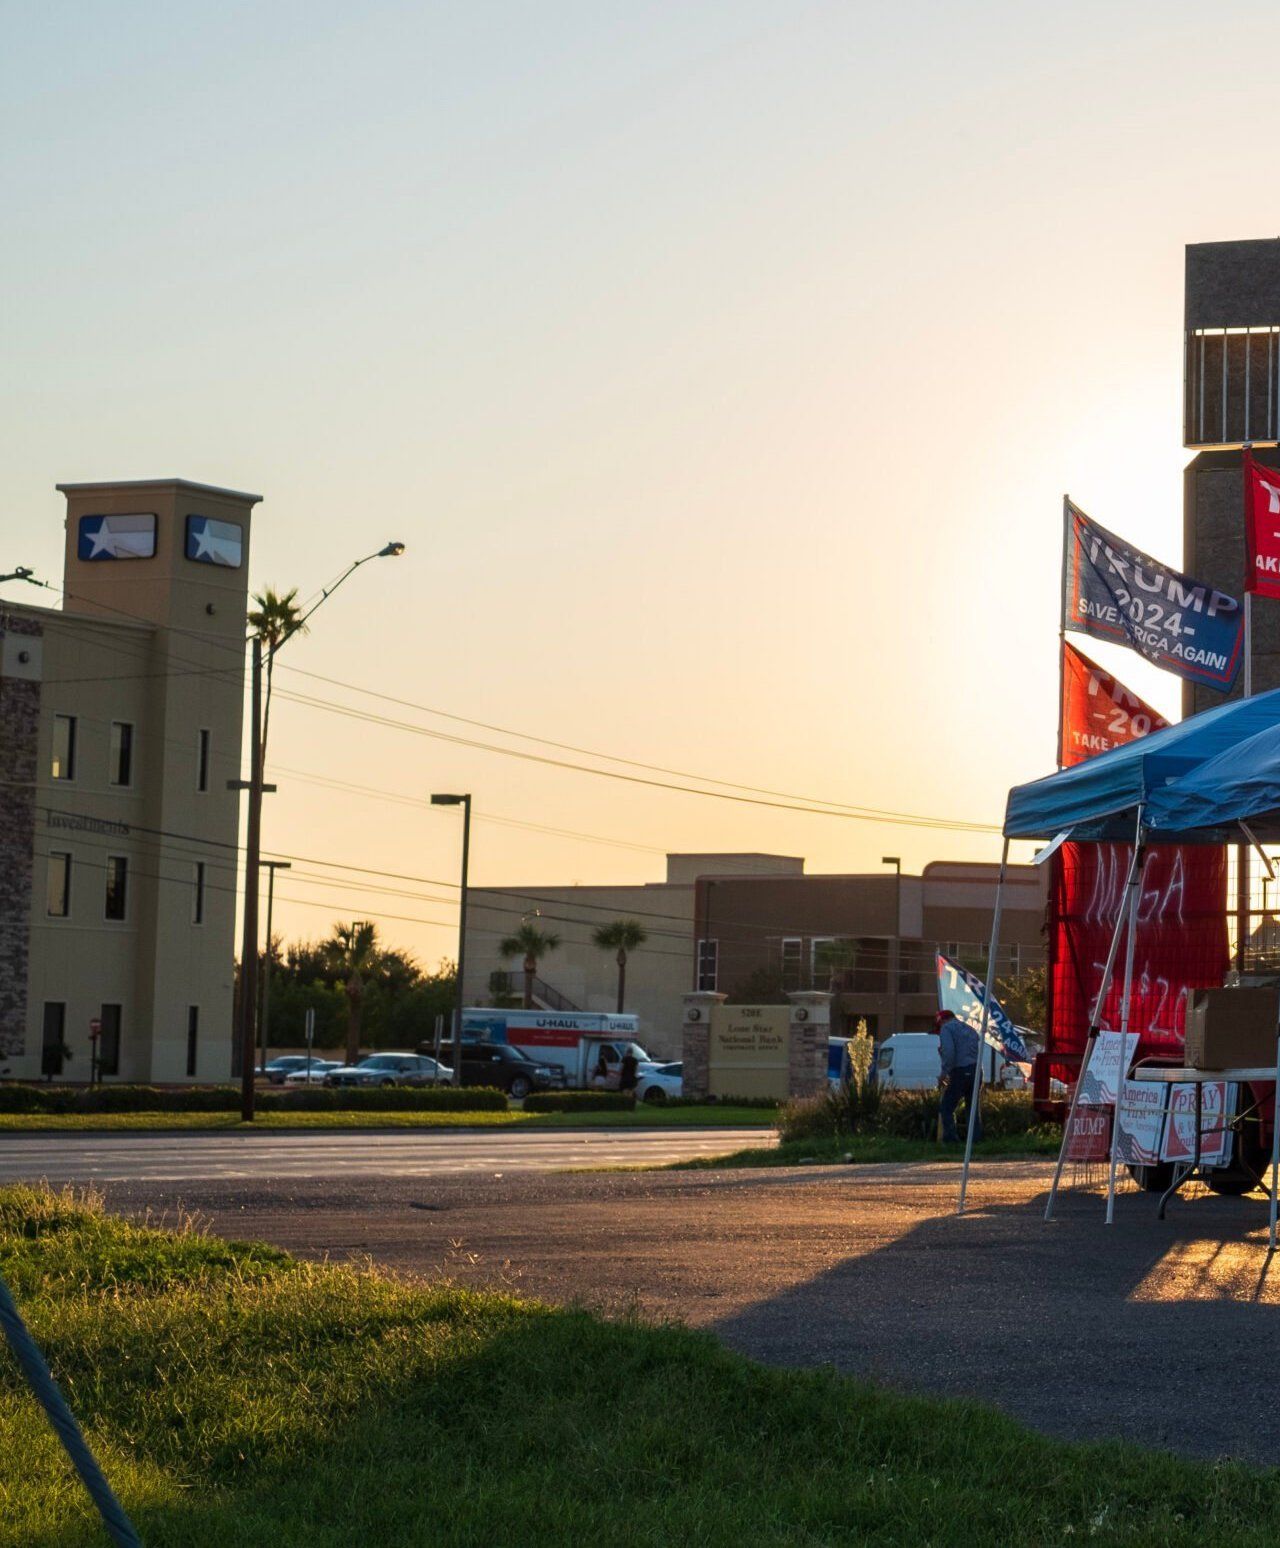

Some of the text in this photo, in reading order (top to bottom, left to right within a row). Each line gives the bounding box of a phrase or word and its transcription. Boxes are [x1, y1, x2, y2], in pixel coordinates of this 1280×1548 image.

[1083, 528, 1239, 617] TRUMP
[1078, 599, 1227, 671] SAVE ARICA AGAIN!
[1073, 732, 1109, 752] TAKE
[536, 1019, 579, 1029] U-HAUL
[609, 1022, 634, 1031] U-HAUL
[1122, 1084, 1158, 1104] America
[1073, 1117, 1105, 1136] RUMP
